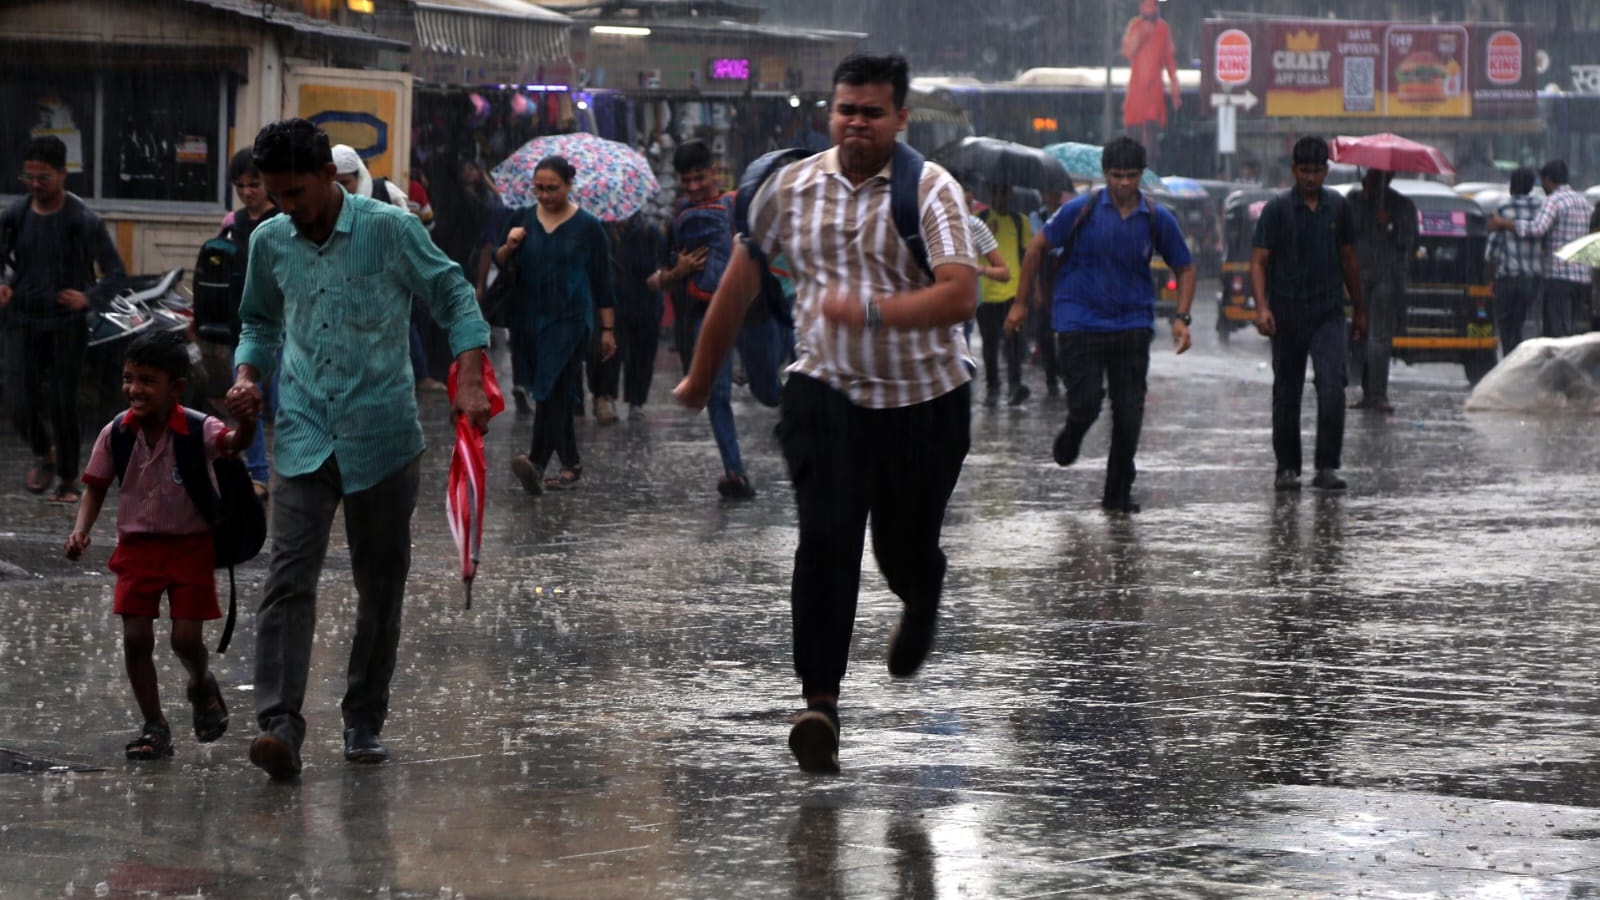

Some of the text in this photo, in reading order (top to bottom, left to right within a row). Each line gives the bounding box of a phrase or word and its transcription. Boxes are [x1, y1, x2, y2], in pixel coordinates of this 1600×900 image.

[1217, 58, 1249, 71] KING
[1272, 50, 1331, 70] CRAZY
[1489, 58, 1519, 71] KING
